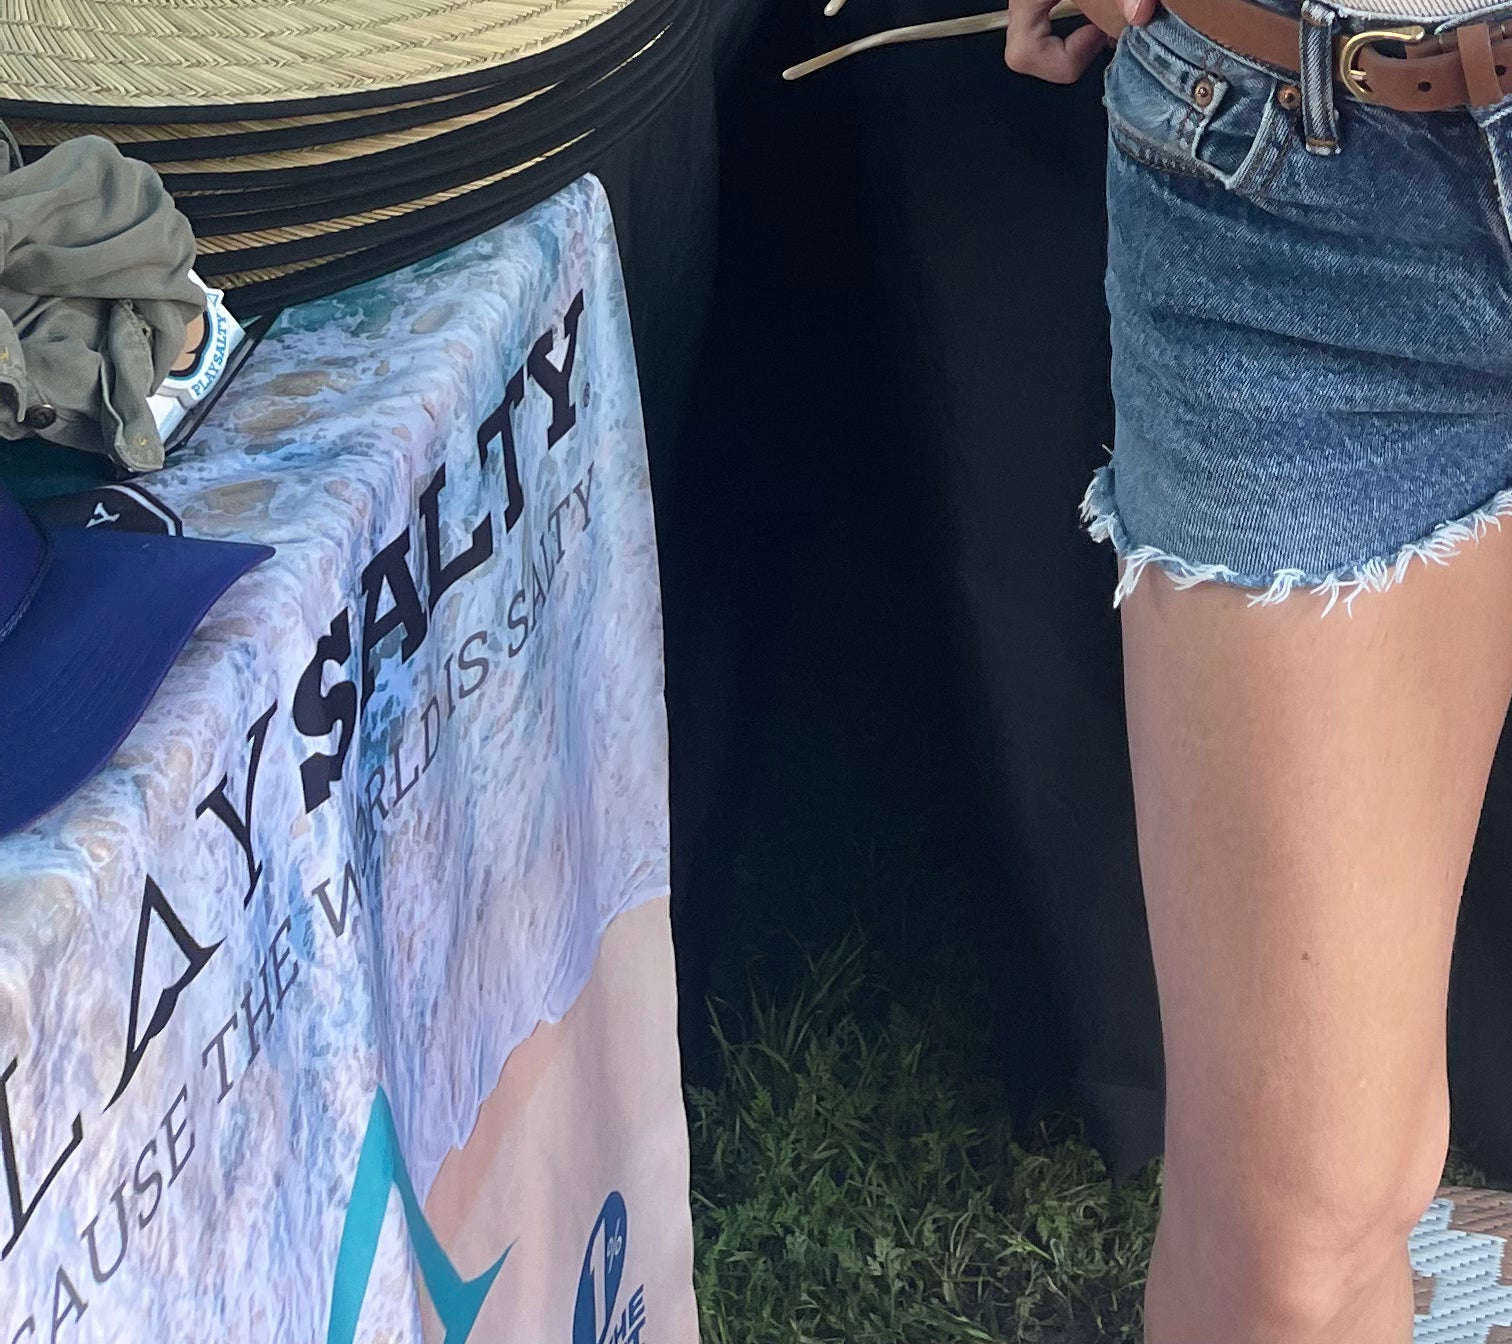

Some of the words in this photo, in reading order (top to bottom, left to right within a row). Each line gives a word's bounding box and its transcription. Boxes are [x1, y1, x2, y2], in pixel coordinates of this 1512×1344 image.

[190, 312, 228, 397] PLAYSALTY
[202, 918, 299, 1104] THE
[443, 628, 491, 722] IS
[508, 460, 596, 659] SALTY
